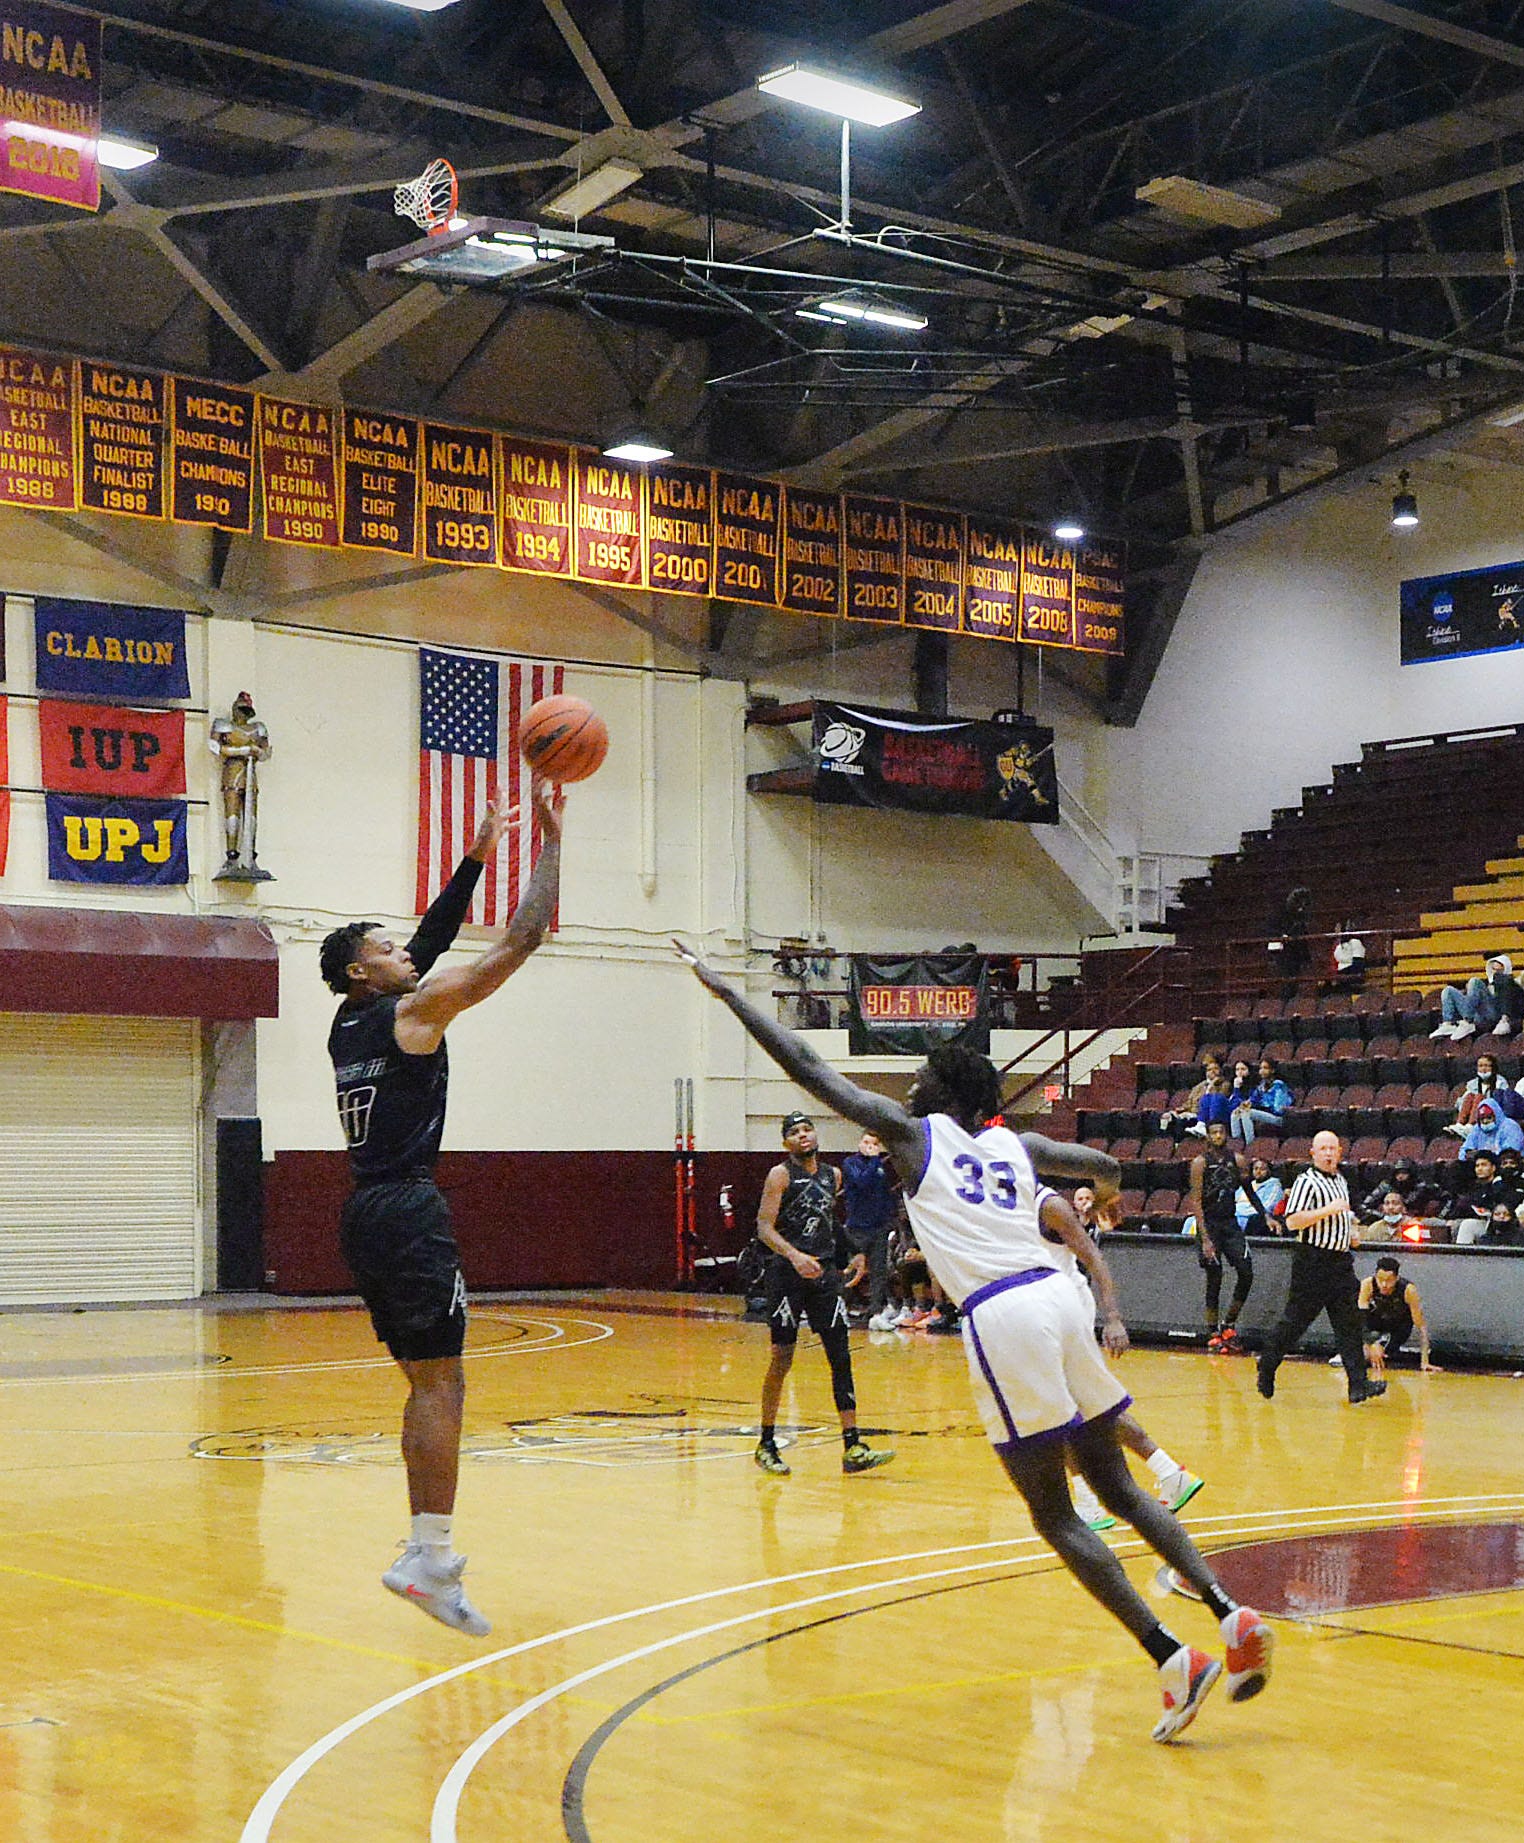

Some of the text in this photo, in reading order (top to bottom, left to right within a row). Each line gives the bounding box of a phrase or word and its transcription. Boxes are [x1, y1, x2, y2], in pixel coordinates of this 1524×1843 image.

[3, 22, 92, 80] NCAA
[0, 384, 68, 411] SKETBALL
[92, 370, 153, 401] NCAA
[10, 409, 48, 430] EAST
[83, 396, 162, 424] BASKETBALL
[186, 396, 246, 428] MECC
[265, 404, 328, 434] NCAA
[0, 429, 63, 456] EGIONAL
[90, 419, 156, 446] NATIONAL
[175, 429, 251, 460] BASKEBALL
[265, 429, 331, 457] BASKETBALL
[354, 417, 408, 448] NCAA
[0, 452, 70, 479] HAMPIONS
[93, 443, 154, 468] QUARTER
[285, 455, 315, 475] EAST
[346, 446, 416, 474] BASKETBALL
[432, 440, 489, 477] NCAA
[94, 465, 155, 490] FINALIST
[181, 460, 247, 488] CHAMONS
[362, 472, 397, 495] ELITE
[511, 453, 561, 489] NCAA
[587, 465, 633, 501] NCAA
[8, 477, 55, 500] 1988
[102, 489, 149, 512] 1988
[271, 474, 328, 499] REGIONAL
[425, 480, 495, 516] BASKETBALL
[653, 475, 707, 511] NCAA
[195, 494, 230, 516] 190
[268, 495, 335, 521] CHAMPIONS
[362, 496, 396, 518] EIGHT
[505, 494, 570, 528] BASKETBALL
[722, 487, 774, 523] NCAA
[791, 500, 838, 533] NCAA
[283, 519, 324, 540] 1990
[362, 521, 399, 543] 1990
[436, 519, 490, 551] 1993
[579, 504, 640, 537] BASKETBALL
[650, 515, 711, 547] BASKETBALL
[851, 510, 898, 543] NCAA
[908, 518, 959, 551] NCAA
[515, 531, 561, 562] 1994
[588, 541, 631, 572] 1995
[970, 530, 1018, 562] NCAA
[1027, 544, 1073, 570] NCAA
[652, 552, 708, 584] 2000
[967, 564, 1017, 594] BASKETBALL
[792, 574, 835, 603] 2002
[854, 583, 898, 609] 2003
[914, 590, 955, 617] 2004
[970, 598, 1013, 627] 2005
[46, 631, 174, 666] CLARION
[68, 725, 161, 773] IUP
[64, 815, 174, 864] UPJ
[867, 991, 910, 1016] 90.5
[953, 1153, 1017, 1210] 33
